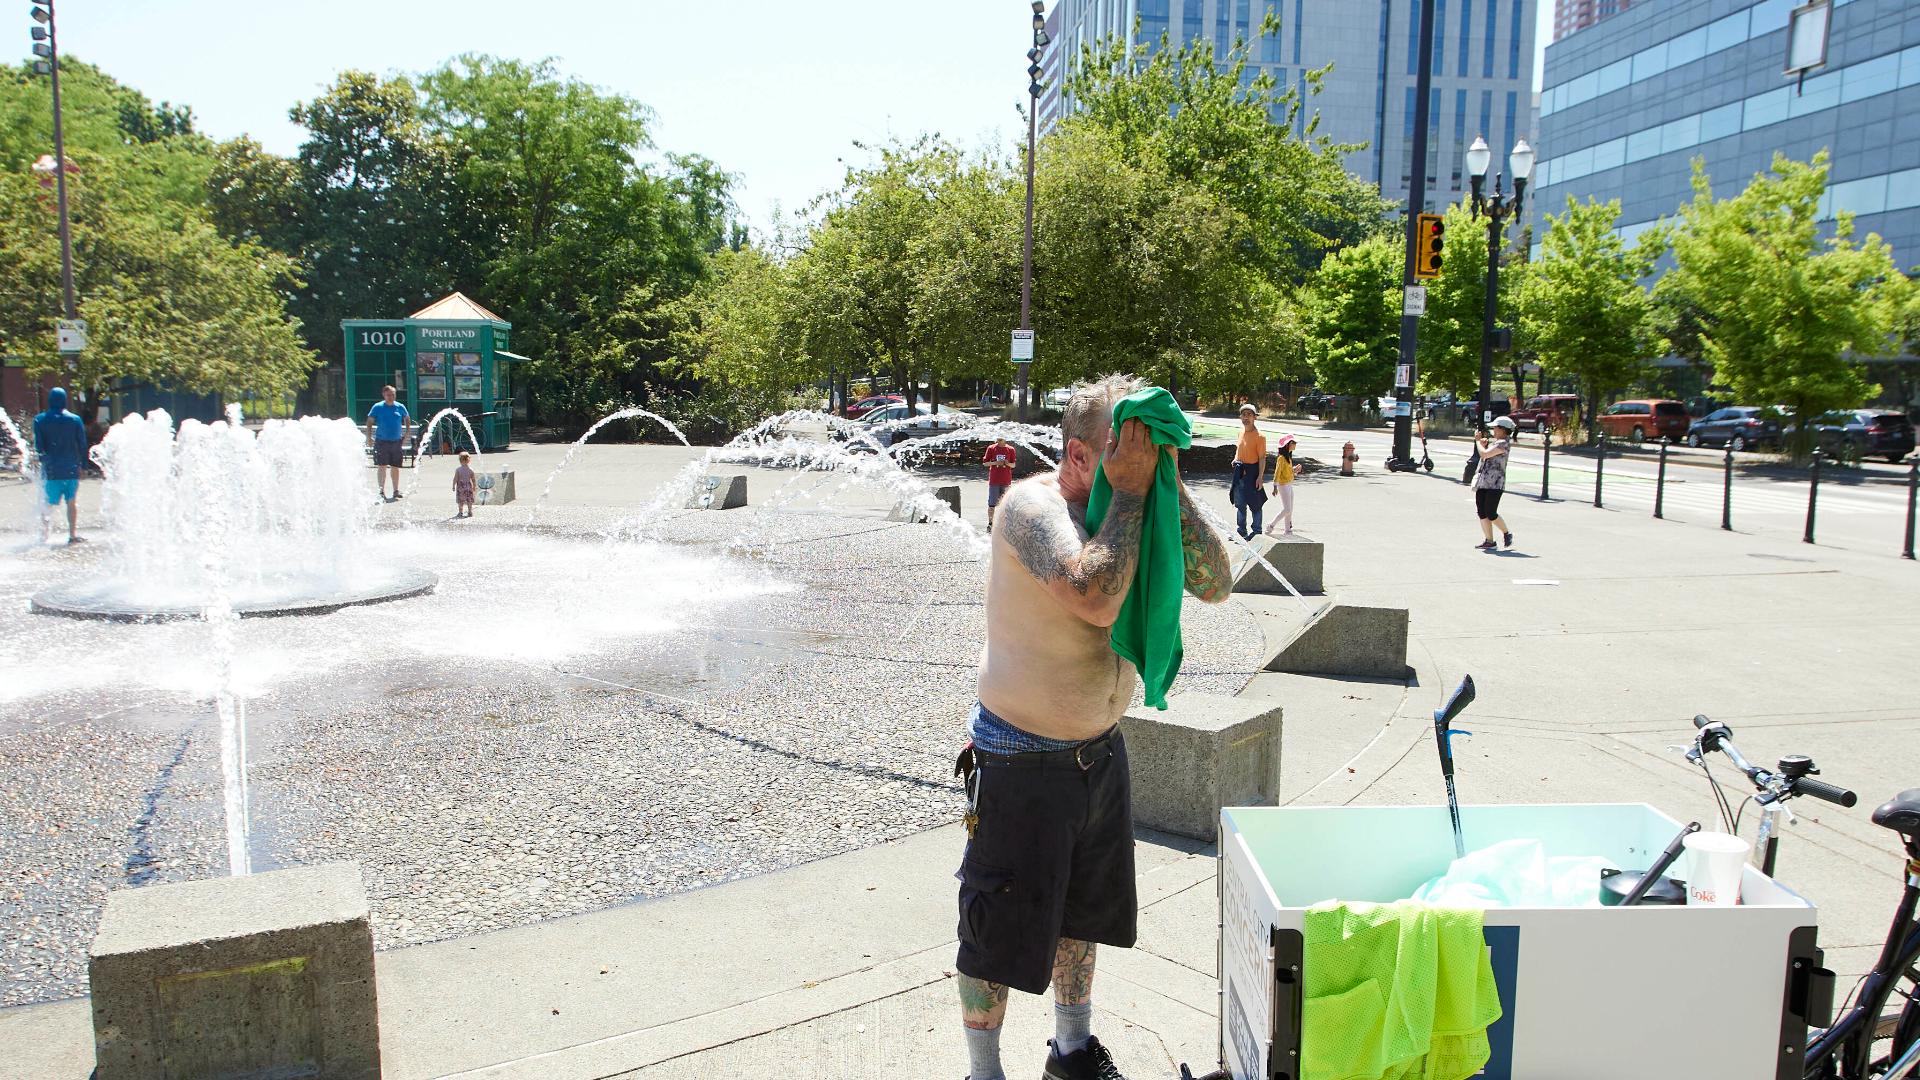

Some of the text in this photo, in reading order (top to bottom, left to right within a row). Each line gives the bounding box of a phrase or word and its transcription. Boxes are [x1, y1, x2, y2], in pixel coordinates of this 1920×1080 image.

[361, 331, 405, 345] 1010
[421, 328, 475, 338] PORTLAND
[431, 339, 465, 349] SPIRIT
[1691, 886, 1716, 902] Coke
[1224, 852, 1252, 925] CENTRAL
[1253, 909, 1269, 957] CITY
[1224, 880, 1268, 1003] CONCERN
